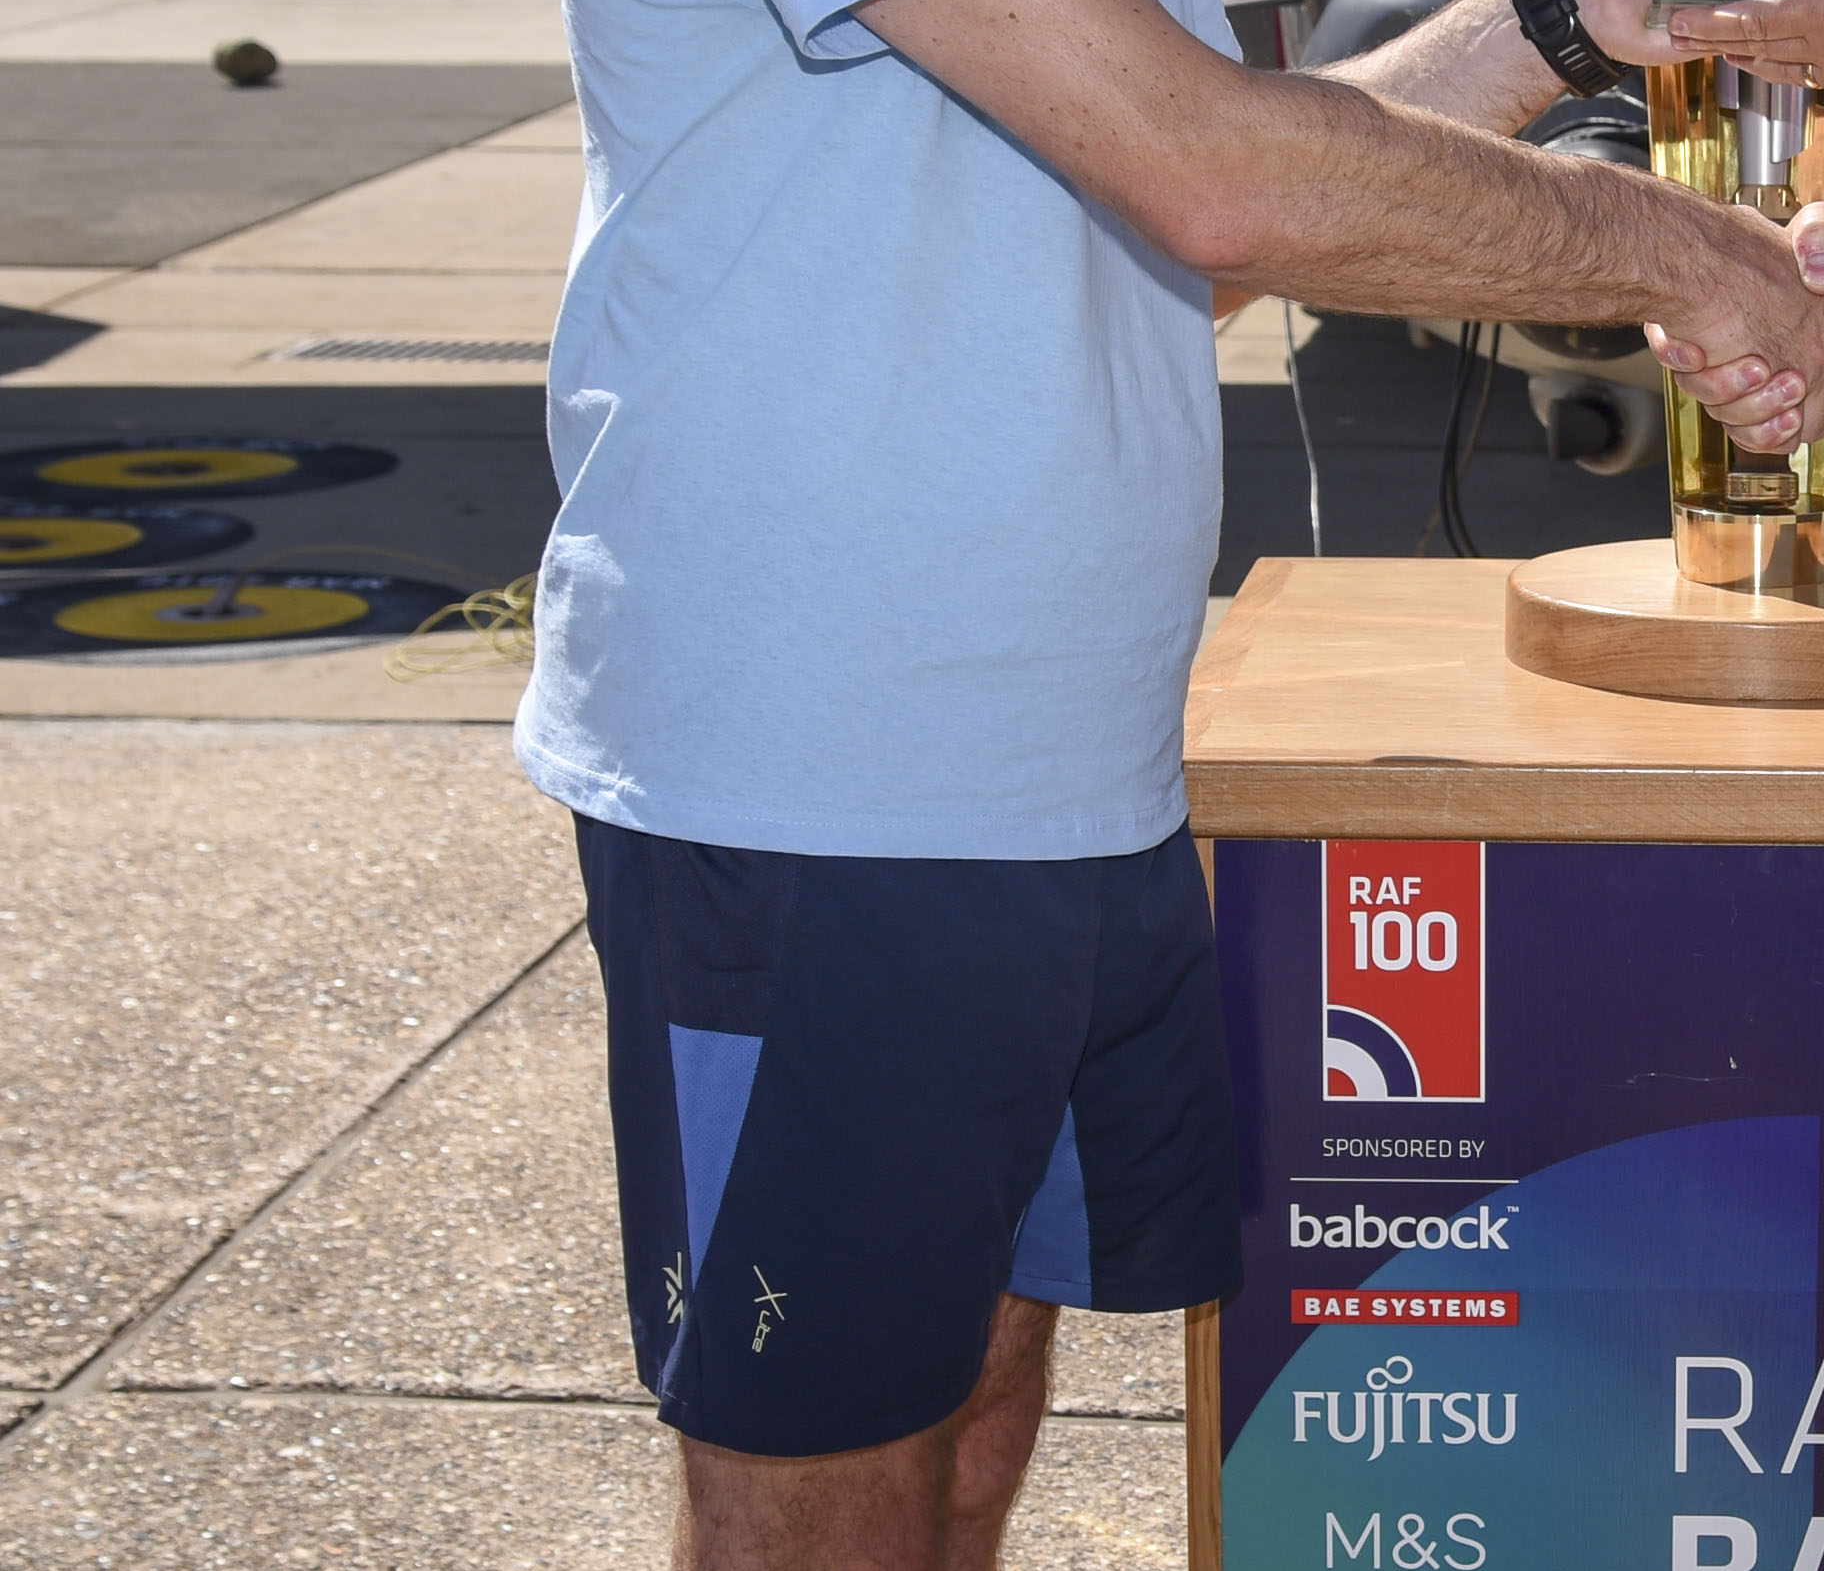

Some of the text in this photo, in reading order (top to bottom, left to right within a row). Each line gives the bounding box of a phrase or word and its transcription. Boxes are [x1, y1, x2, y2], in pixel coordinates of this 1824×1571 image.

[1349, 876, 1421, 905] RAF
[1349, 911, 1458, 972] 100
[1322, 1138, 1485, 1159] SPONSORED BY
[1290, 1204, 1510, 1250] babcock
[1304, 1297, 1507, 1318] BAE SYSTEMS
[1292, 1359, 1518, 1462] FUJITSU
[1325, 1512, 1487, 1571] M&S
